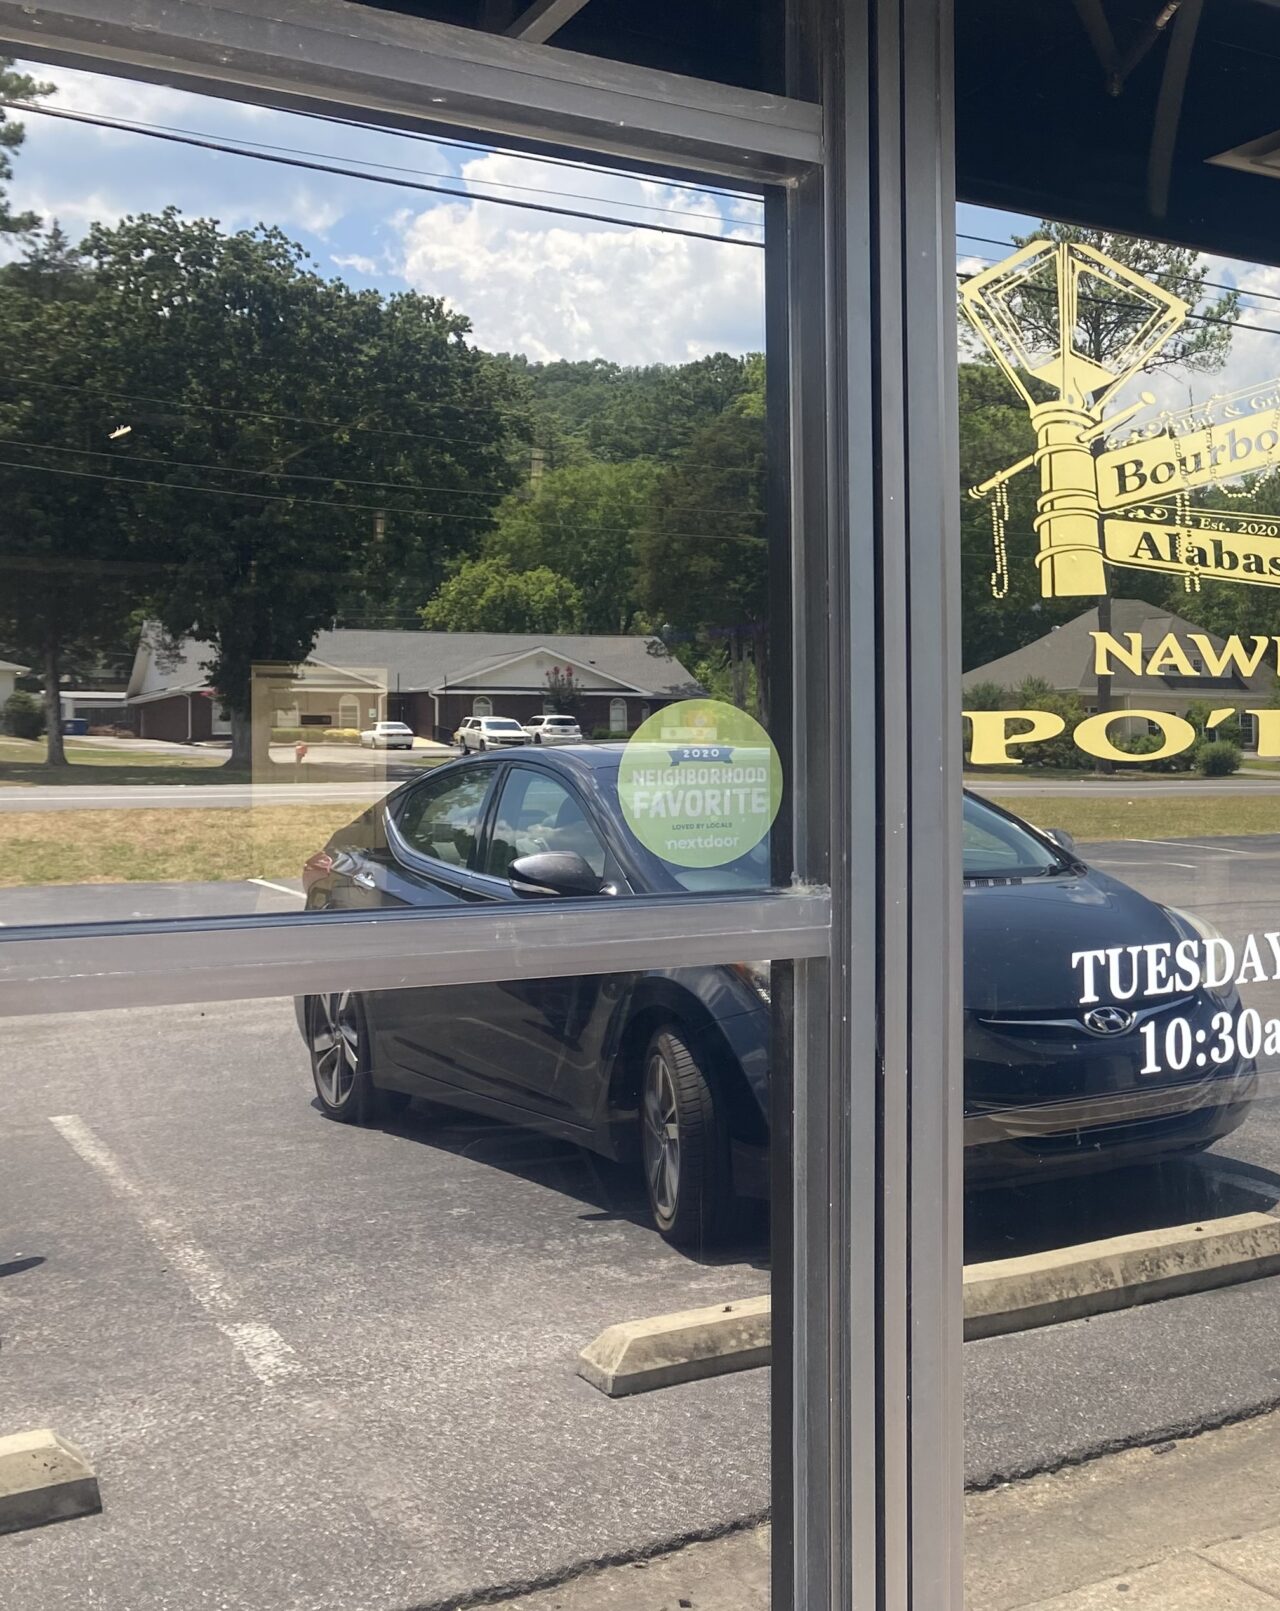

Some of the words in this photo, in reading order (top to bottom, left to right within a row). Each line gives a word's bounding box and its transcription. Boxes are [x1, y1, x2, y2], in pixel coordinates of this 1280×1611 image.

[1180, 412, 1216, 434] Bar
[1224, 405, 1243, 419] &
[1199, 517, 1231, 532] Est.
[1238, 521, 1278, 537] 2020
[682, 748, 720, 758] 2020
[632, 767, 768, 787] NEIGHBORHOOD
[633, 788, 769, 819] FAVORITE
[671, 823, 695, 831] LOVED
[665, 834, 739, 850] nextdoor
